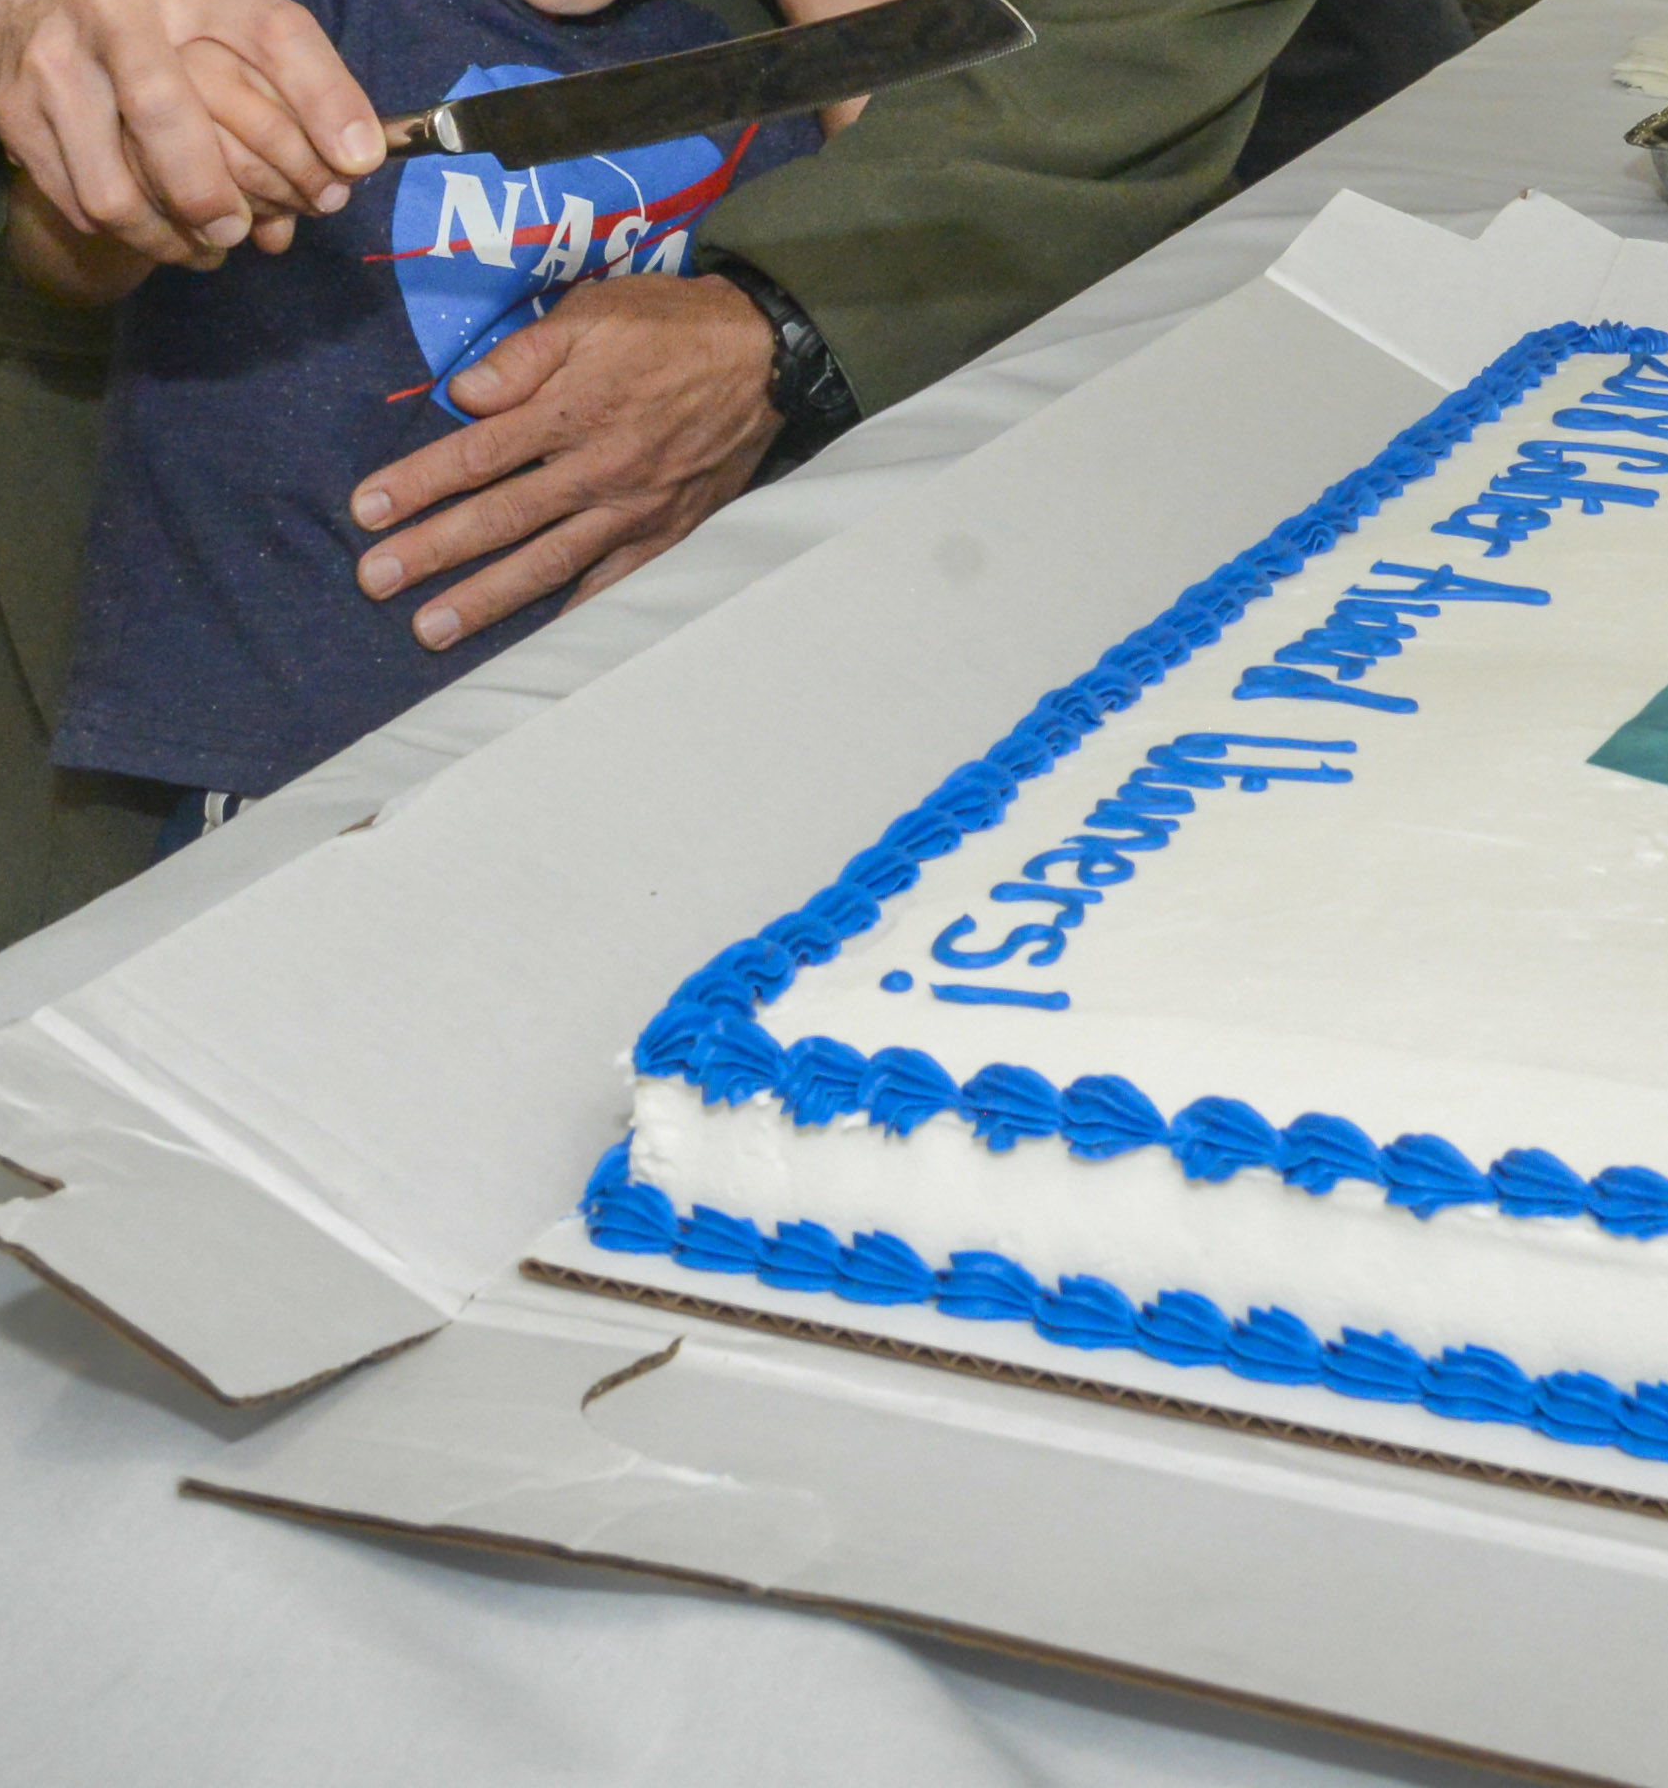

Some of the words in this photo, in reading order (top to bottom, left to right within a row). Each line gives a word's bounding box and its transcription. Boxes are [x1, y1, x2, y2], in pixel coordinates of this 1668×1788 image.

[425, 169, 690, 283] NASA
[1235, 560, 1552, 714] Award
[880, 732, 1357, 1011] Winners!
